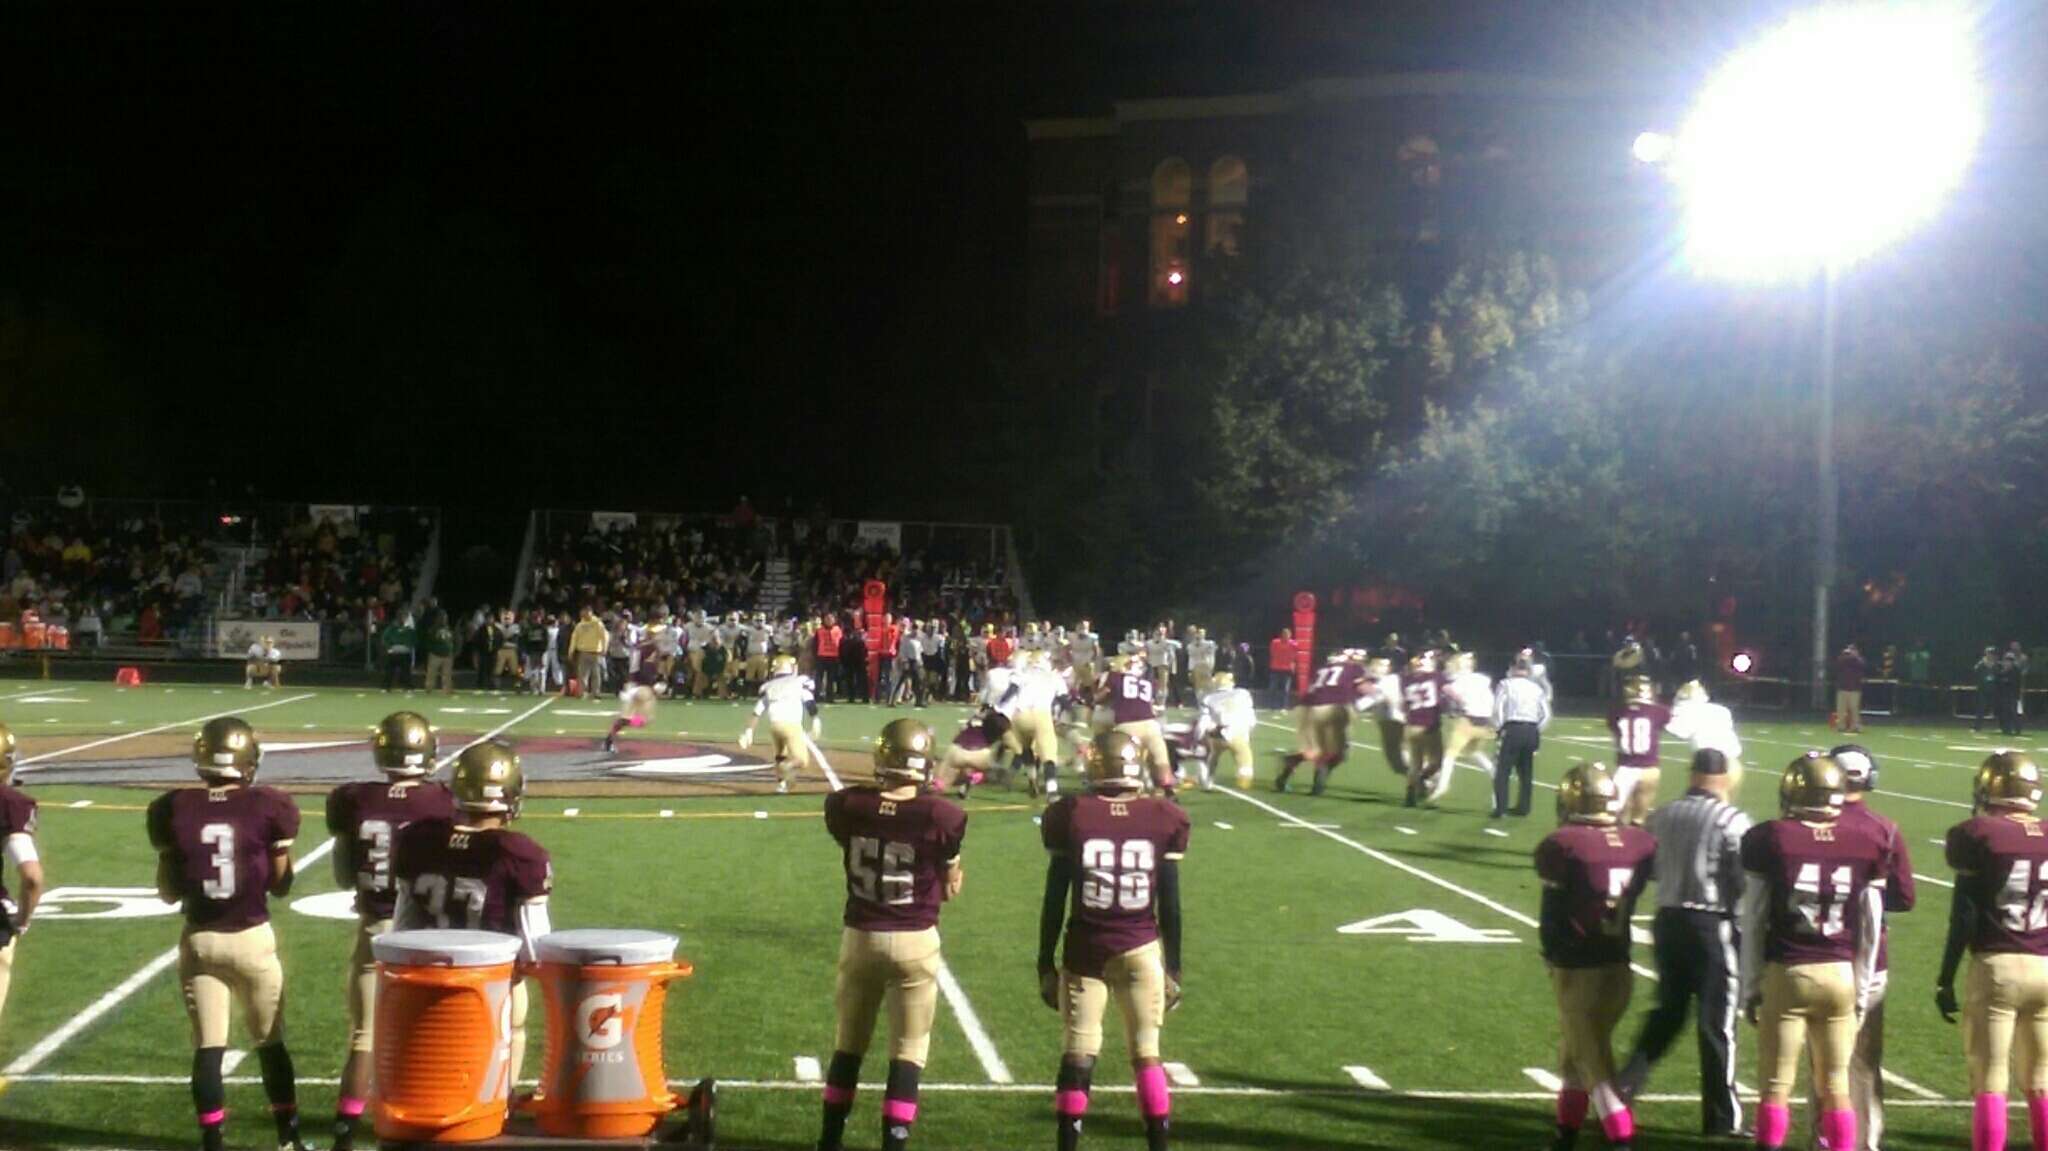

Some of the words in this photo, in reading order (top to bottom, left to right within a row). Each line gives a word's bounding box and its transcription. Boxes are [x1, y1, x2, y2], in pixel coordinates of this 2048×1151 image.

[1123, 676, 1153, 703] 63
[201, 823, 235, 899] 3
[358, 820, 402, 892] 3
[849, 836, 916, 906] 56
[576, 994, 623, 1050] G
